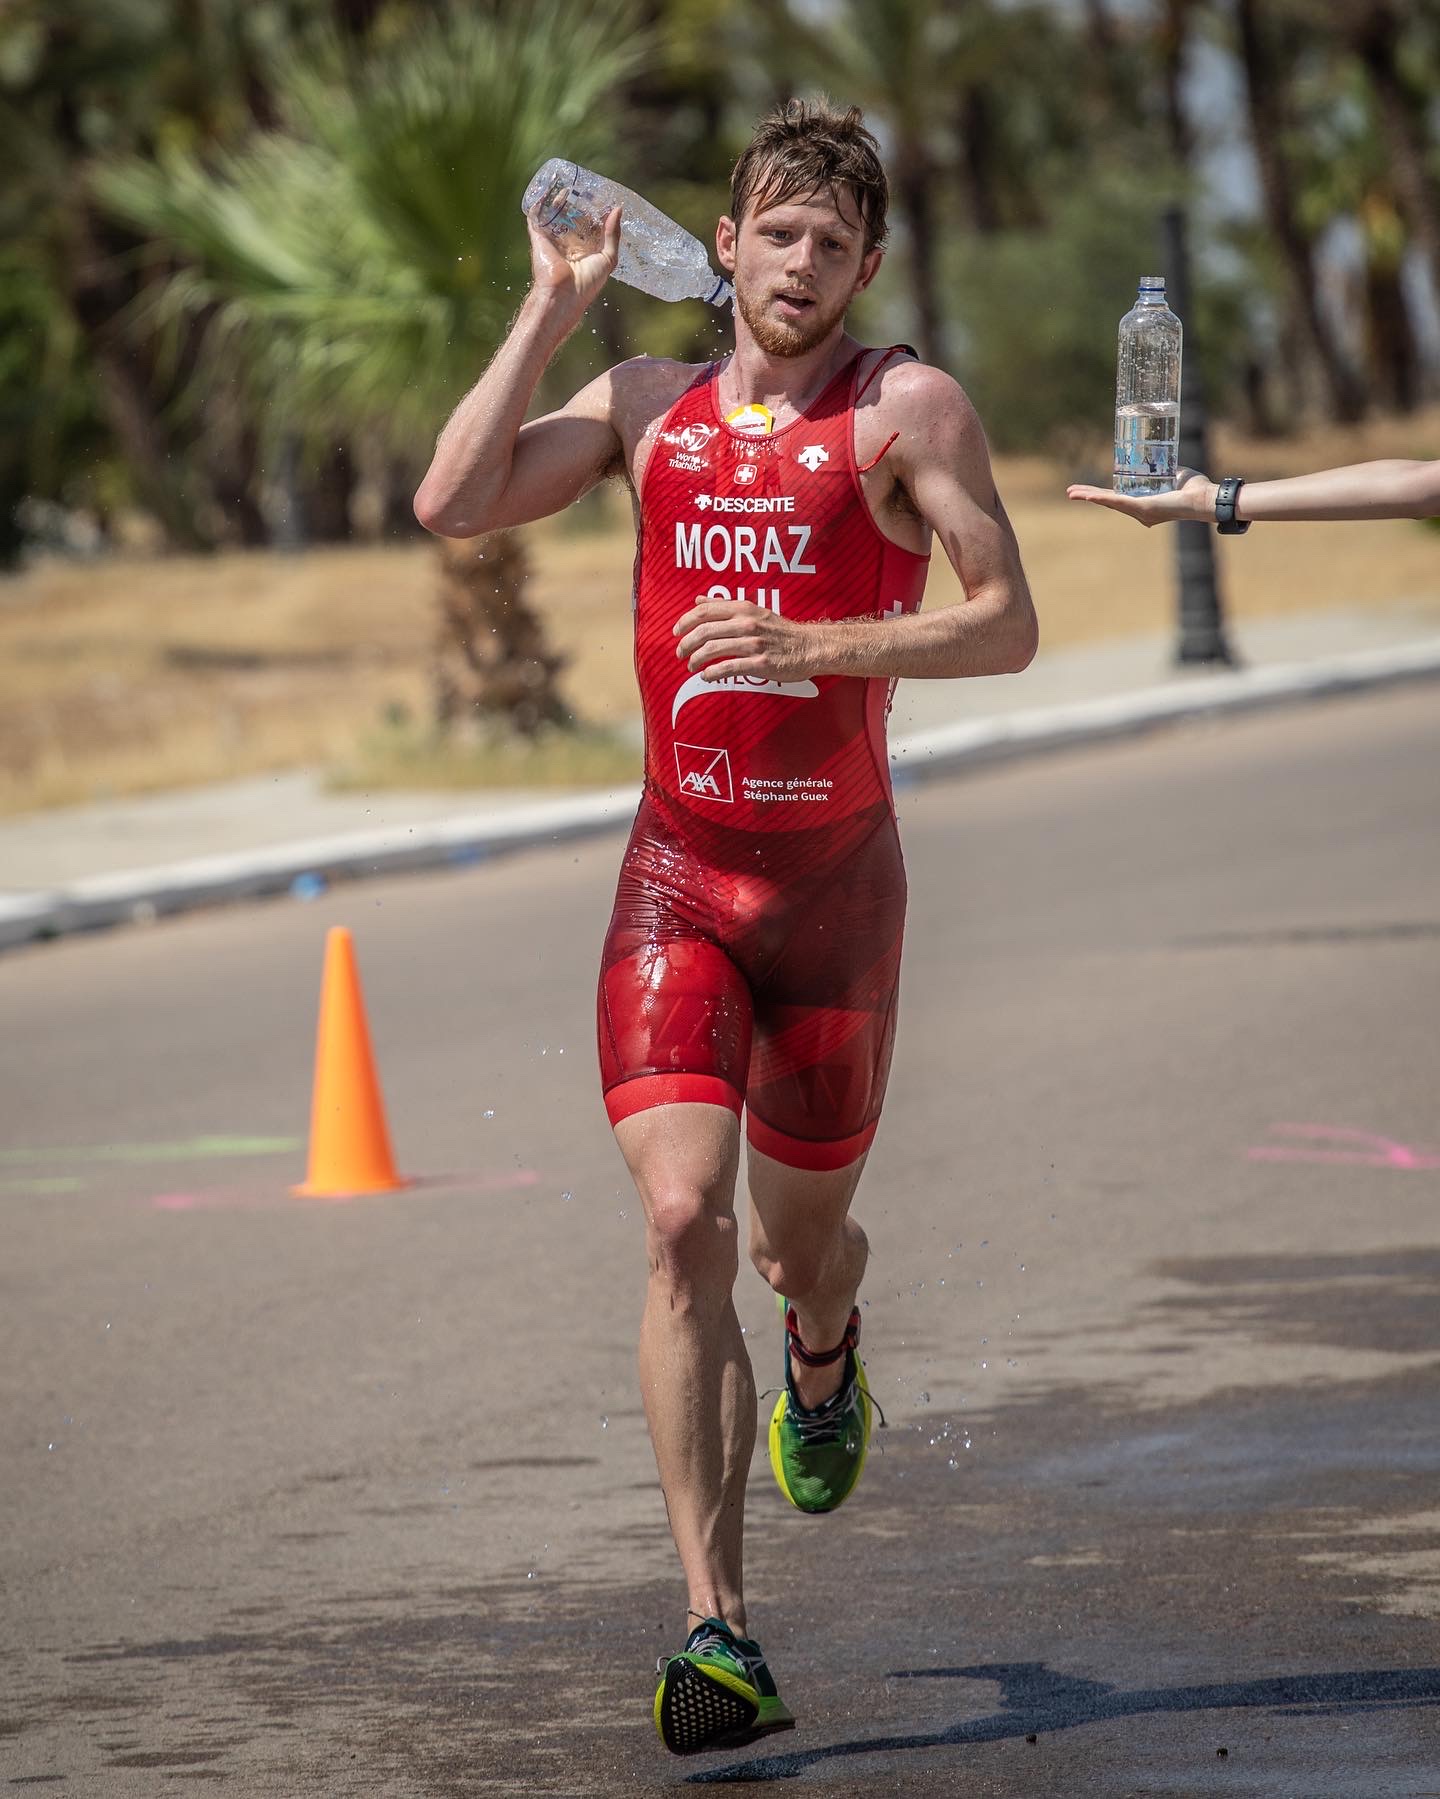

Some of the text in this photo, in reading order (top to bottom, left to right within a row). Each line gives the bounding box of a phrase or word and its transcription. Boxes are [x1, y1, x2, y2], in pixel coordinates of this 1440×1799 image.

[669, 459, 701, 472] Triathlon
[713, 496, 795, 512] DESCENTE
[676, 522, 816, 574] MORAZ
[681, 772, 721, 796] AXA
[741, 777, 833, 790] Agence générale
[743, 790, 829, 802] Stéphane Guex
